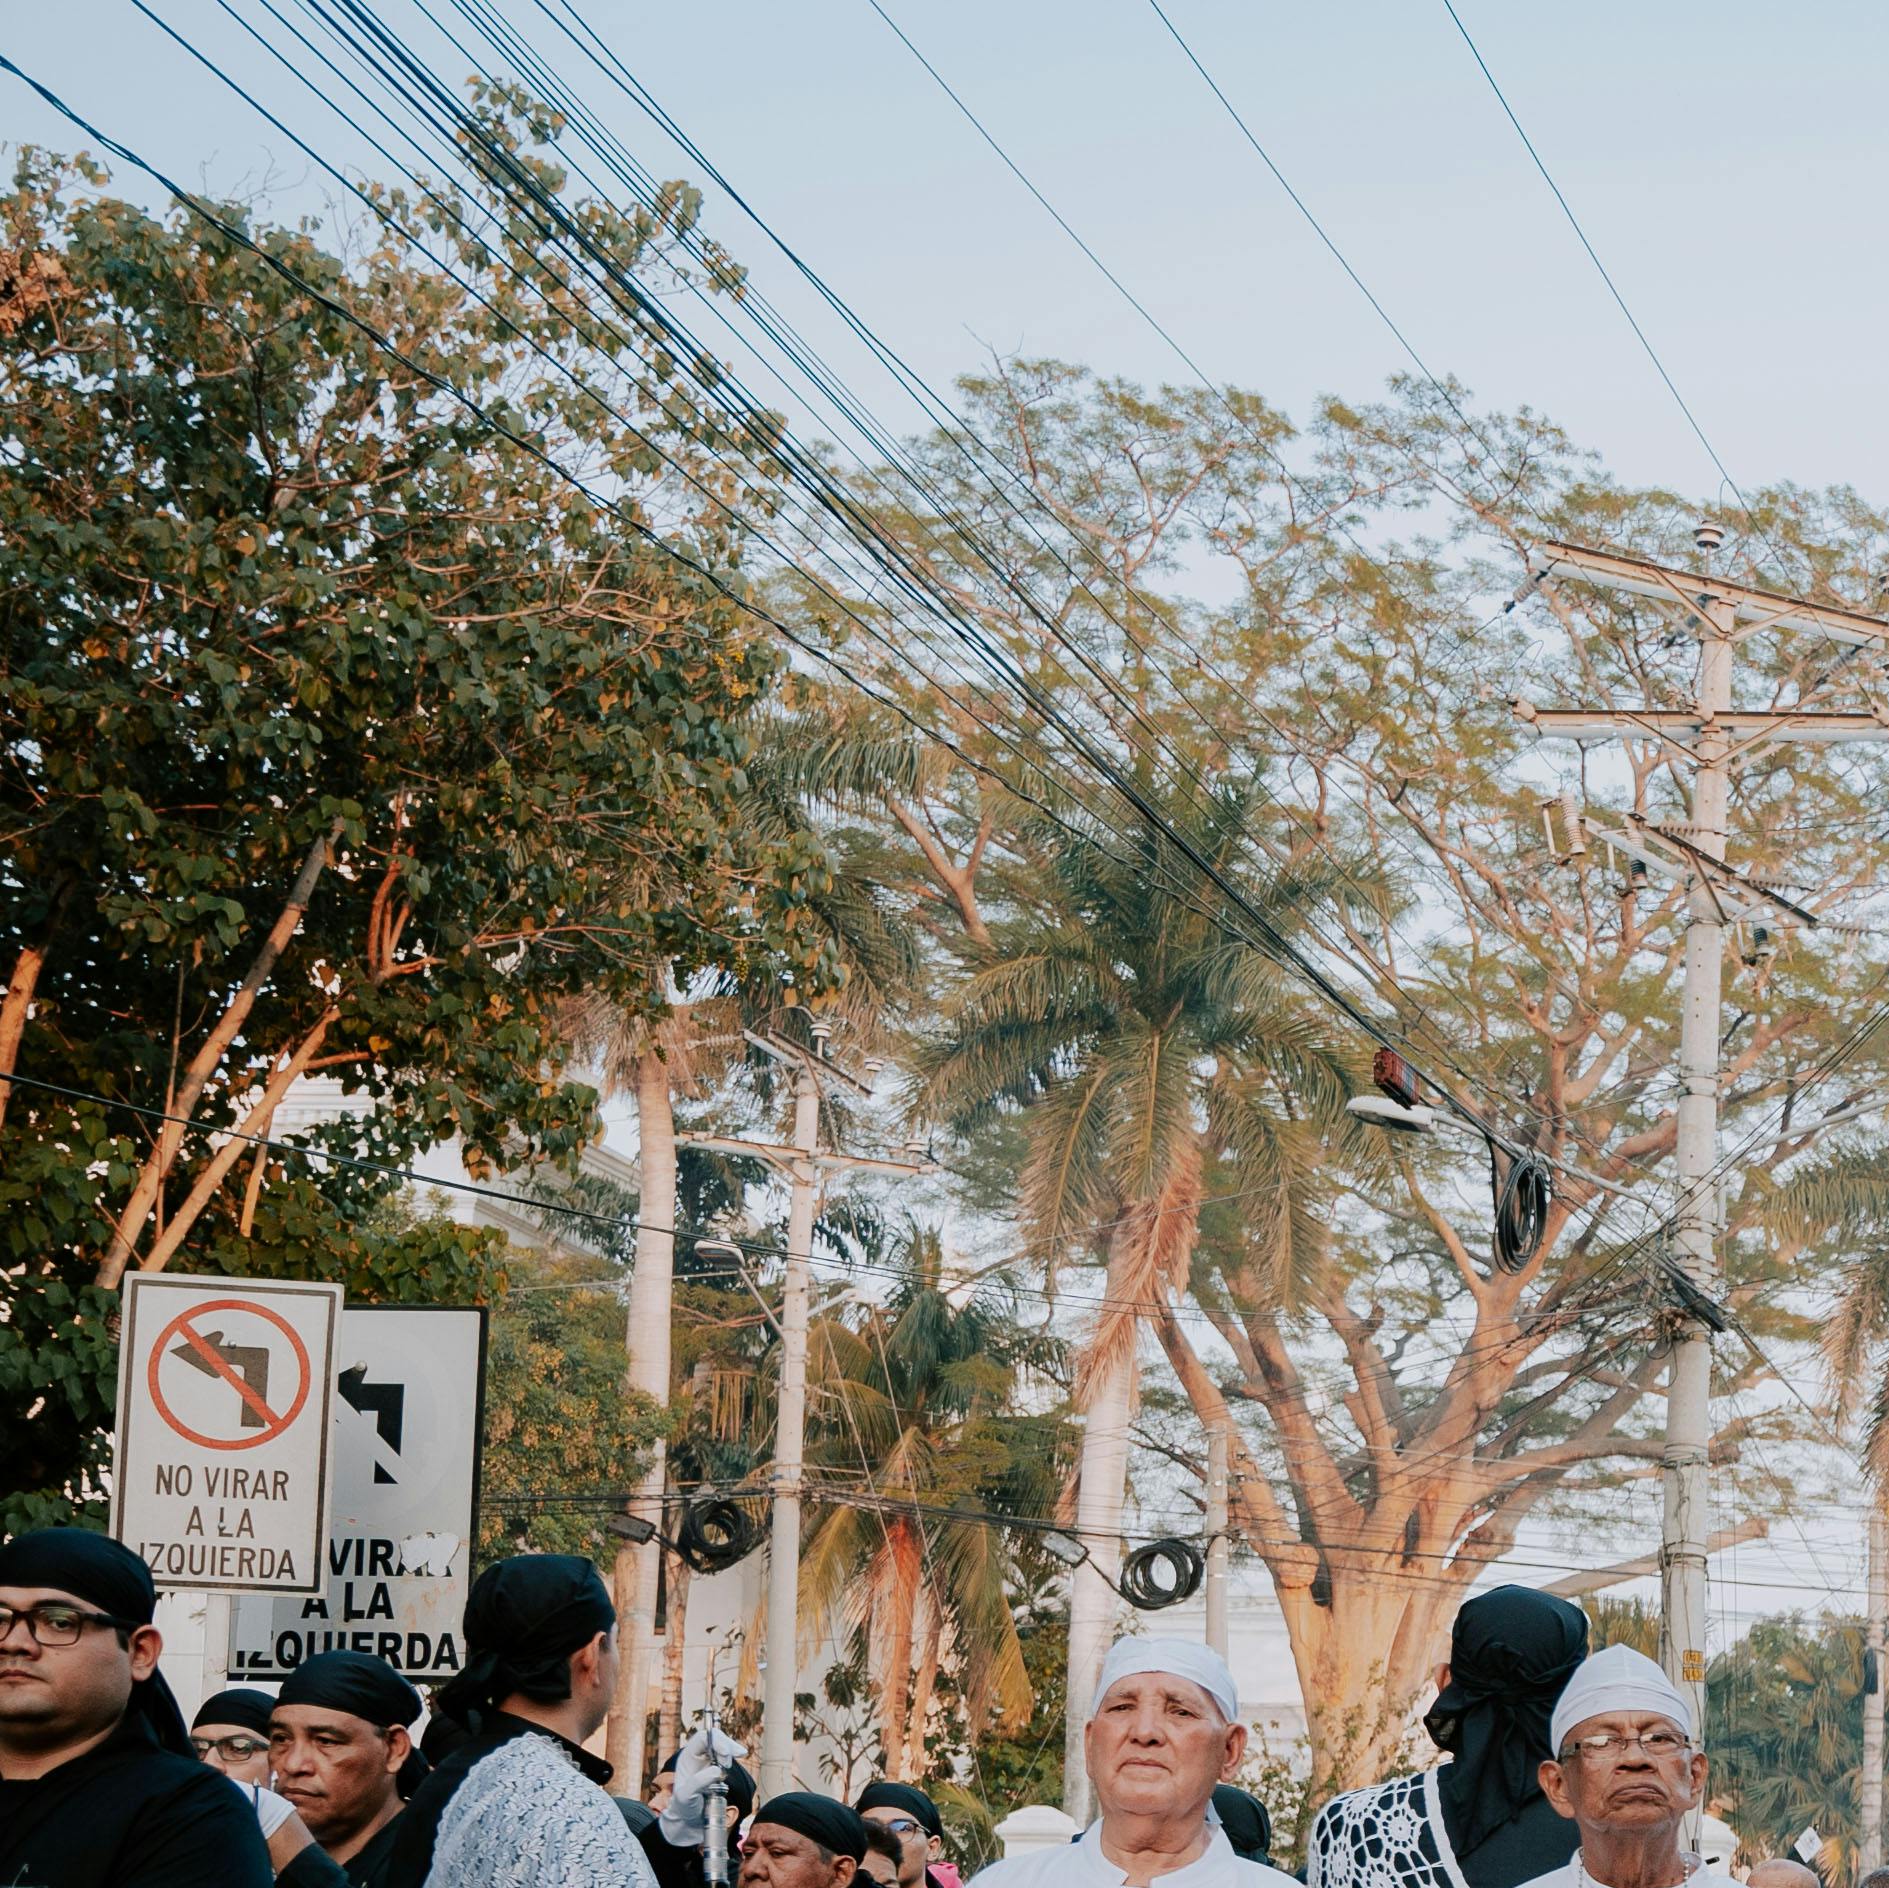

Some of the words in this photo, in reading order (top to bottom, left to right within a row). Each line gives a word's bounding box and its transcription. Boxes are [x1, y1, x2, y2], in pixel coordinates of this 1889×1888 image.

[155, 1464, 193, 1497] NO
[204, 1466, 290, 1501] VIRAR
[185, 1505, 204, 1537] A
[217, 1506, 255, 1539] LA
[140, 1542, 296, 1581] IZQUIERDA
[329, 1538, 453, 1578] VIR
[301, 1598, 330, 1619] A
[343, 1582, 395, 1622] LA
